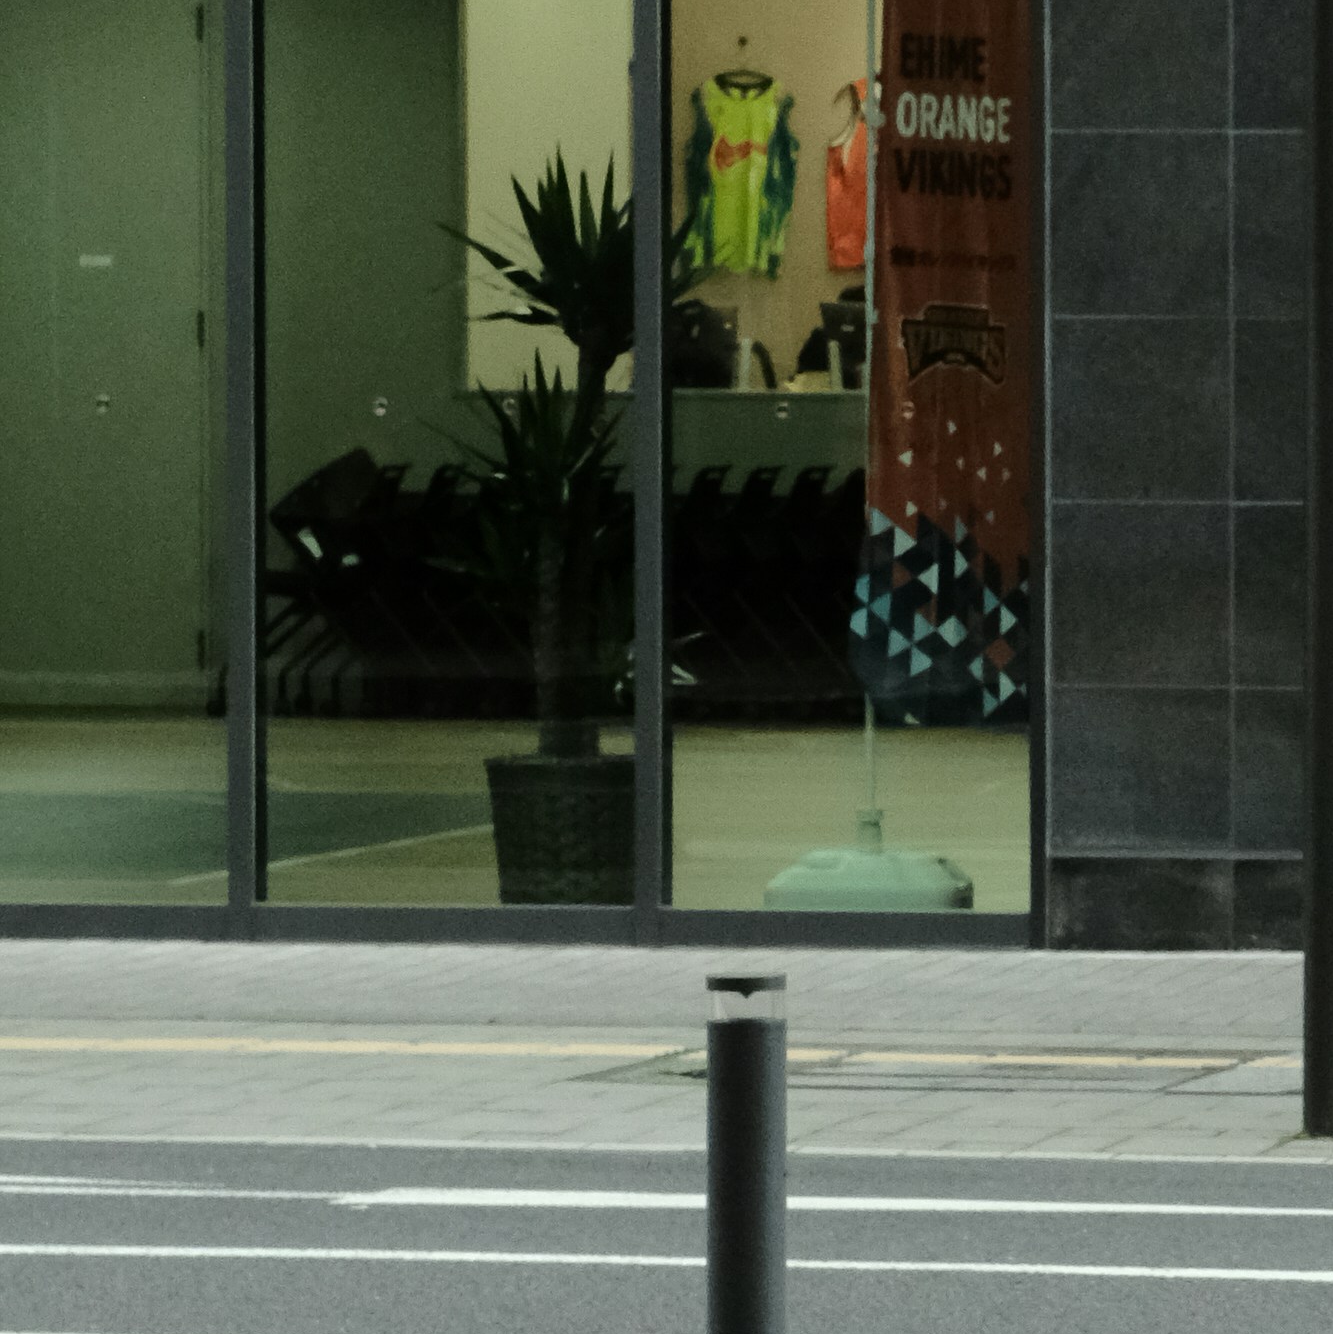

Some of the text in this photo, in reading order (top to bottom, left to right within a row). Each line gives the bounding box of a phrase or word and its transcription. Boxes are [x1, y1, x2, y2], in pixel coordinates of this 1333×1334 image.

[901, 33, 986, 84] EHIME
[896, 91, 1011, 144] ORANGE
[894, 148, 1011, 200] VIKINGS
